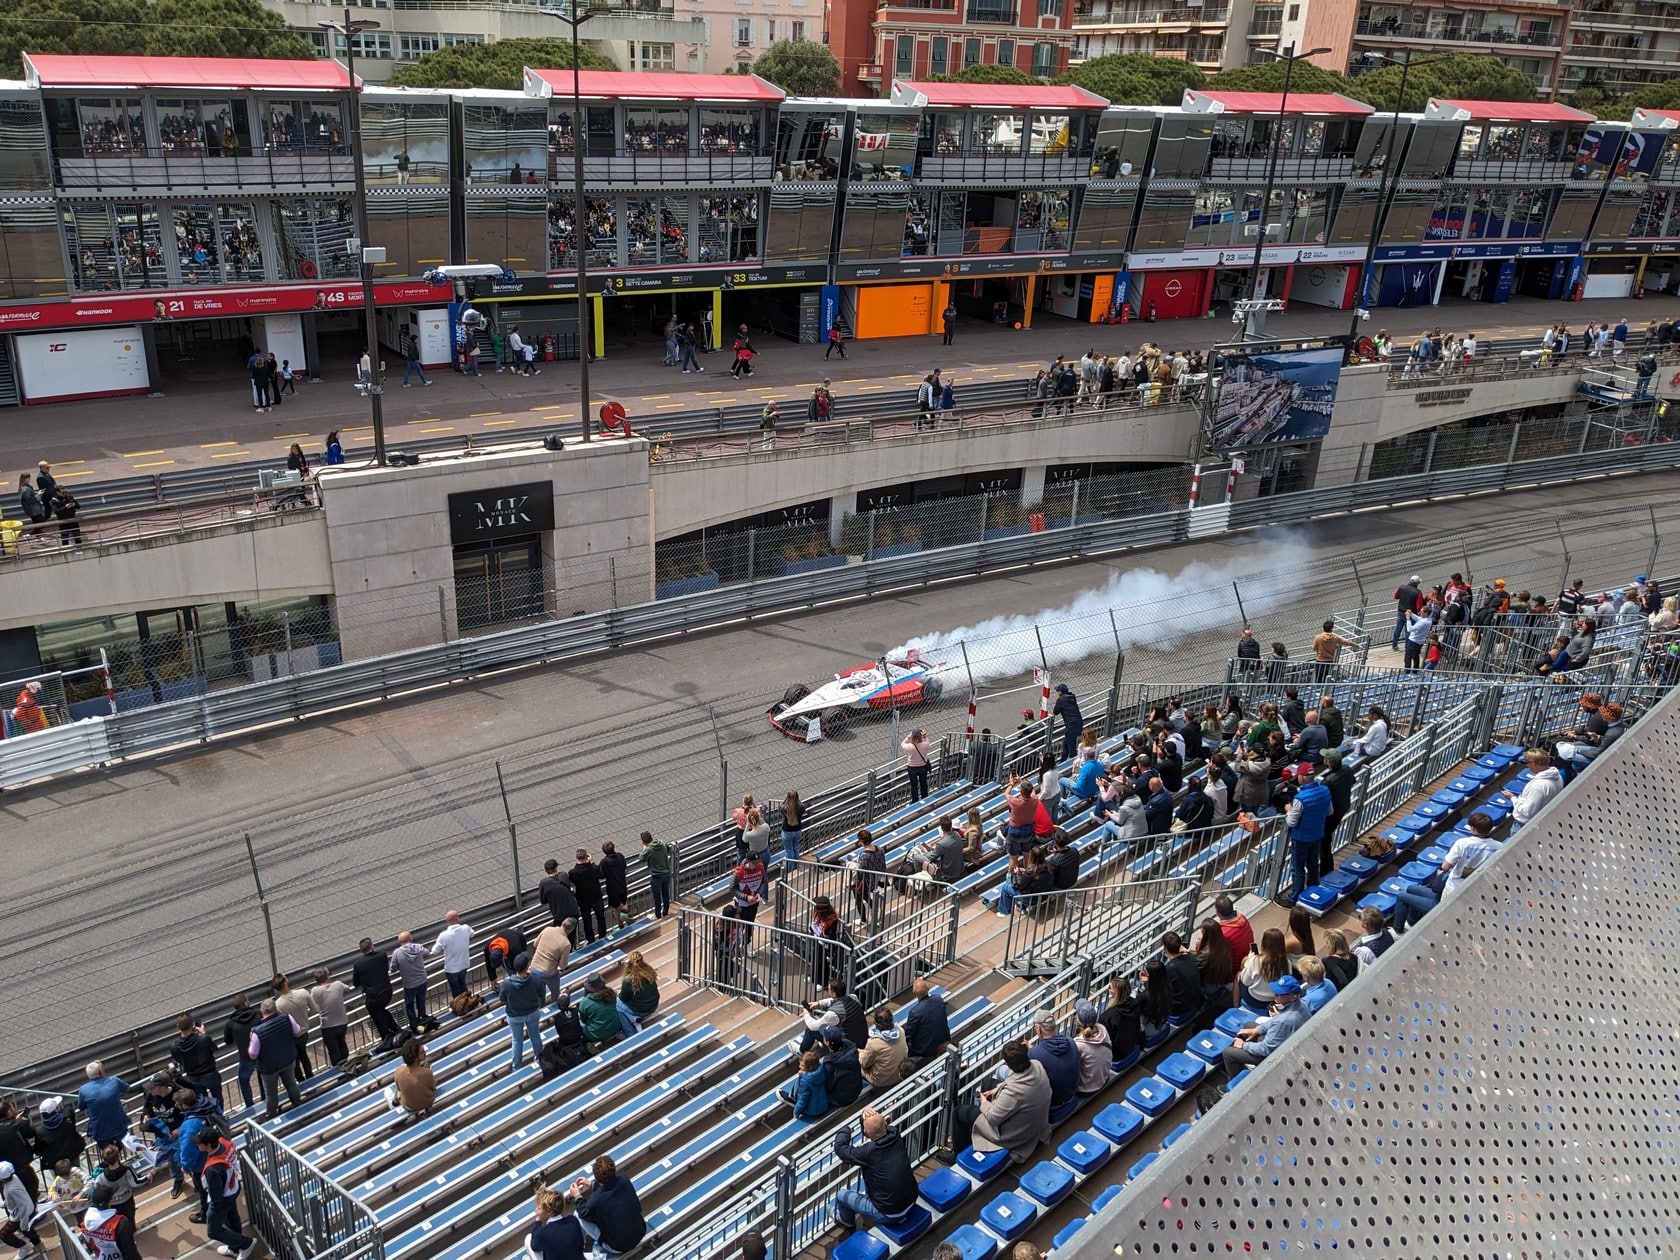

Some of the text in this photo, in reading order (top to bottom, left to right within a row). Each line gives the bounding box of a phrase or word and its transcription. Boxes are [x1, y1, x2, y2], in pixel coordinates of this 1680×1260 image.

[1302, 251, 1312, 259] 22
[615, 278, 624, 287] 3
[733, 273, 746, 282] 33
[327, 291, 344, 302] 48
[169, 300, 185, 312] 21
[474, 496, 532, 530] MK
